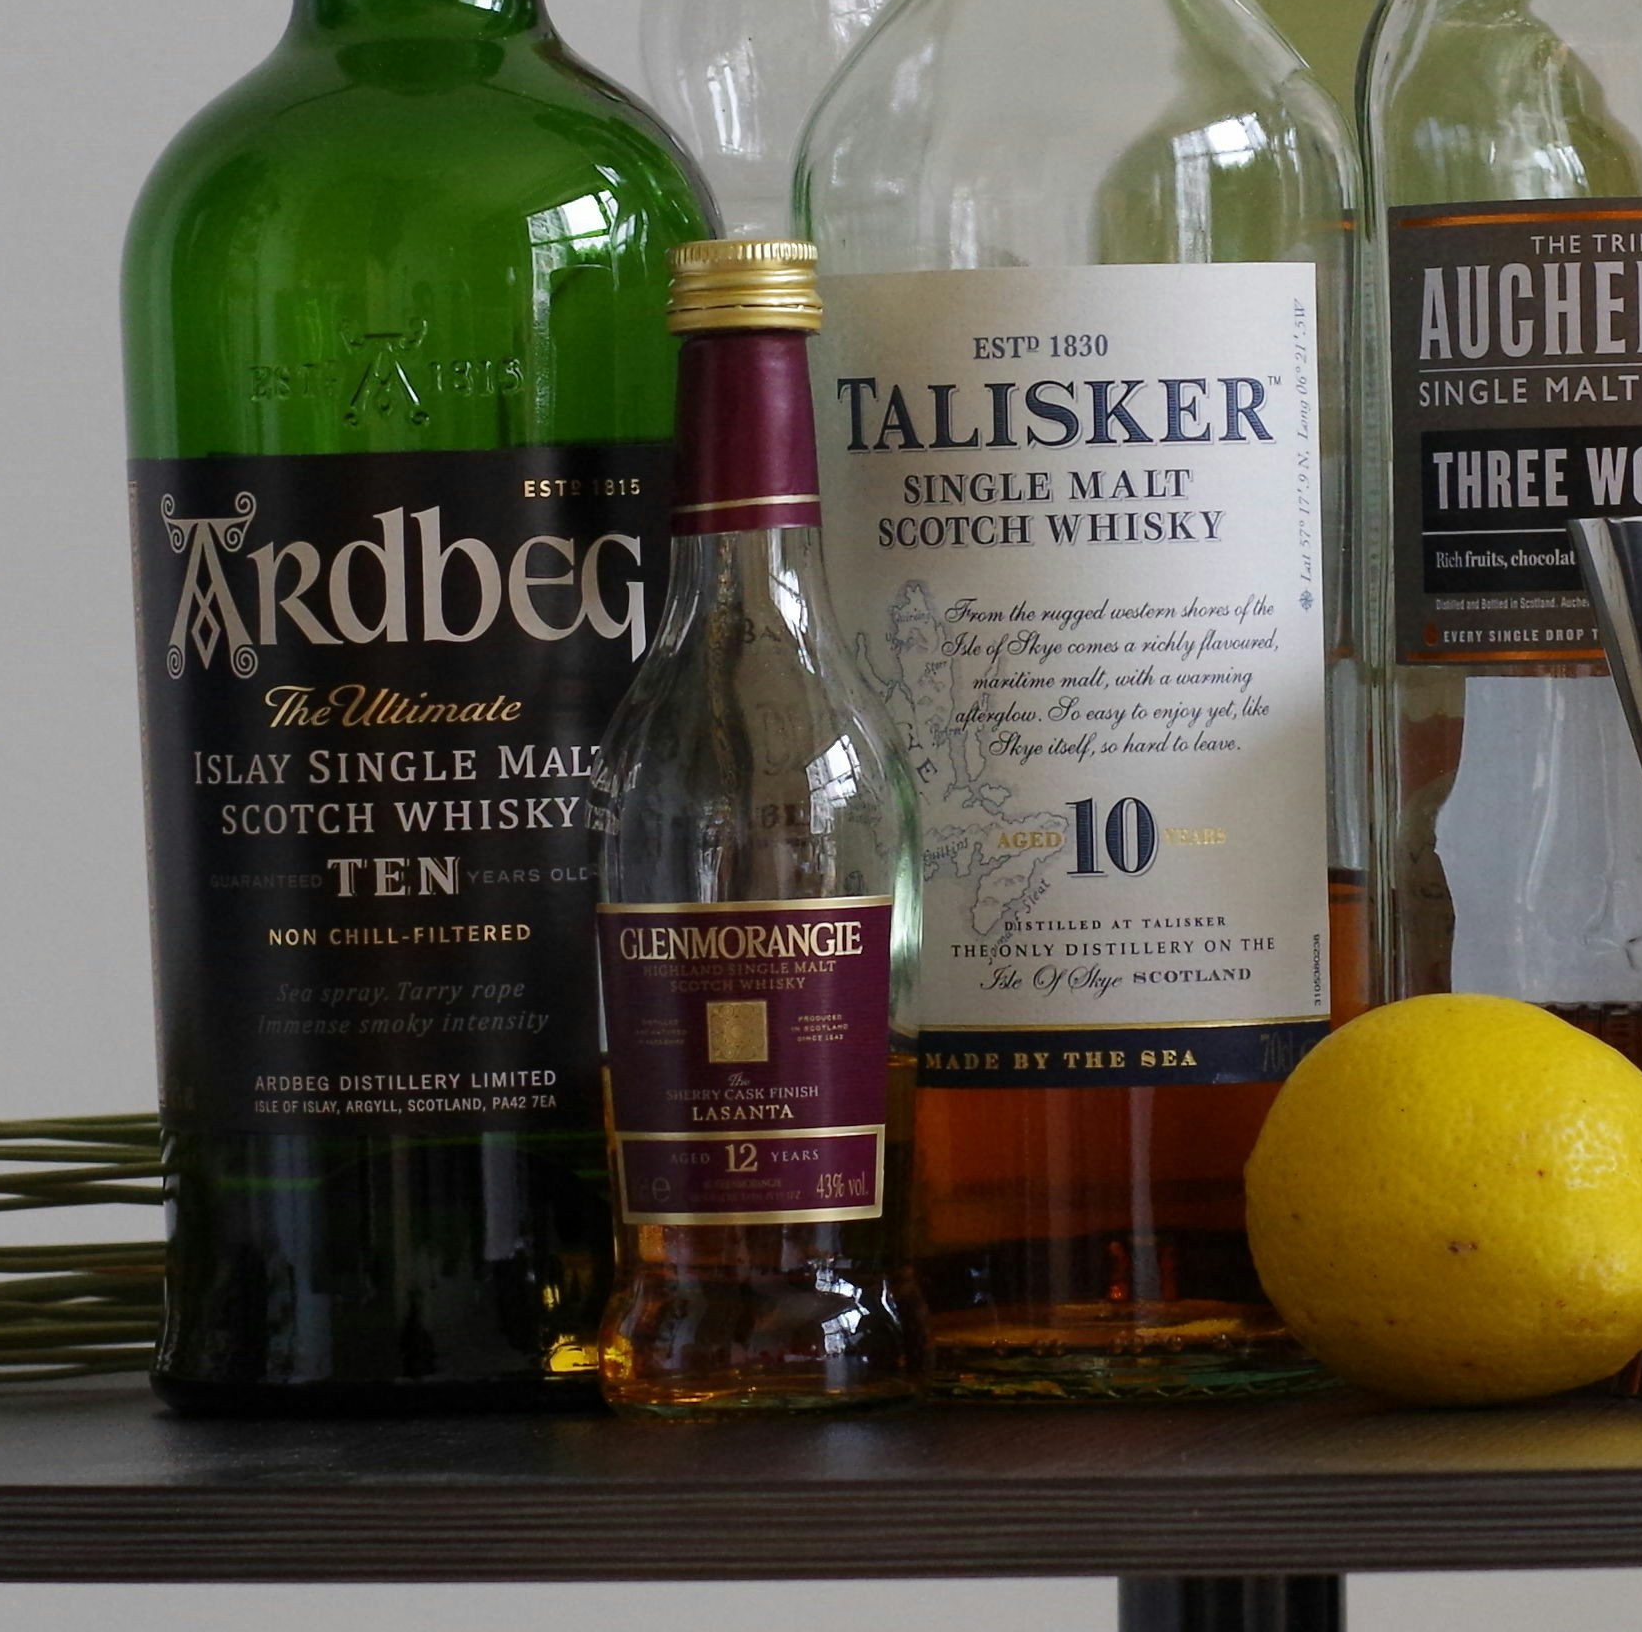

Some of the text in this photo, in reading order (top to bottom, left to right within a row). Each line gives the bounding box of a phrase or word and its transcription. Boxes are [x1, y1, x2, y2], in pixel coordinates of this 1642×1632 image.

[1531, 235, 1581, 255] THE
[1050, 334, 1109, 358] 1830
[1419, 379, 1528, 407] SINGLE
[1545, 375, 1640, 402] MALT
[592, 478, 642, 497] 1815
[904, 469, 1191, 505] SINGLE MALT
[1433, 448, 1569, 510] THREE
[879, 510, 1224, 549] SCOTCH WHISKY
[1436, 548, 1463, 569] Rich
[1464, 548, 1508, 570] fruits,
[160, 490, 646, 680] Ardbeg
[944, 598, 1005, 626] From
[1008, 597, 1036, 623] the
[1041, 601, 1108, 631] rugged
[1111, 600, 1177, 620] western
[1181, 597, 1230, 619] shores
[1234, 594, 1253, 627] of
[1252, 593, 1275, 616] the
[942, 628, 1280, 665] Isle of Skye comes a richly flavoured,
[1443, 630, 1483, 643] EVERY
[1488, 629, 1539, 643] SINGLE
[1545, 628, 1584, 641] DROP
[972, 668, 1253, 694] maritime malt, with a warming
[264, 684, 523, 729] The Ultimate
[955, 702, 1042, 737] afterglow.
[1048, 697, 1081, 722] So
[1085, 707, 1127, 731] easy
[1131, 703, 1148, 720] to
[1152, 703, 1203, 732] enjoy
[1207, 701, 1238, 729] yet,
[1242, 696, 1270, 717] like
[988, 729, 1242, 766] Skye itself, so hard to leave.
[195, 752, 291, 786] ISLAY
[308, 748, 478, 785] SINGLE
[222, 796, 580, 835] SCOTCH WHISKY
[997, 795, 1227, 876] AGED 10 YEARS
[209, 872, 324, 890] GUARANTEED
[327, 855, 461, 898] TEN
[467, 867, 541, 884] YEARS
[268, 923, 533, 946] NON CHILL-FILTERED
[1004, 915, 1226, 932] DISTILLED AT TALISKER
[620, 920, 864, 961] GLENMORANGIE
[951, 936, 1275, 959] THE ONLY DISTILLERY ON THE
[642, 960, 837, 978] HIGHLAND SINGLE MALT
[980, 966, 1251, 998] Isle Of Skye SCOTLAND
[277, 980, 526, 1008] Sea spray. Tarry rope
[670, 976, 806, 993] SCOTCH WHISKY
[258, 1010, 550, 1040] Immense smoky intensity
[925, 1048, 1198, 1070] MADE BY THE SEA
[255, 1070, 557, 1093] ARDBEG DISTILLERY LIMITED
[666, 1084, 819, 1102] SHERRY CASK FINISH
[254, 1093, 557, 1115] ISLE OF ISLAY, ARGYLL, SCOTLAND, PA42 7EA
[692, 1103, 795, 1122] LASANTA
[670, 1142, 820, 1172] AGED 12 YEARS
[816, 1172, 846, 1200] 43%
[848, 1170, 870, 1197] vol.
